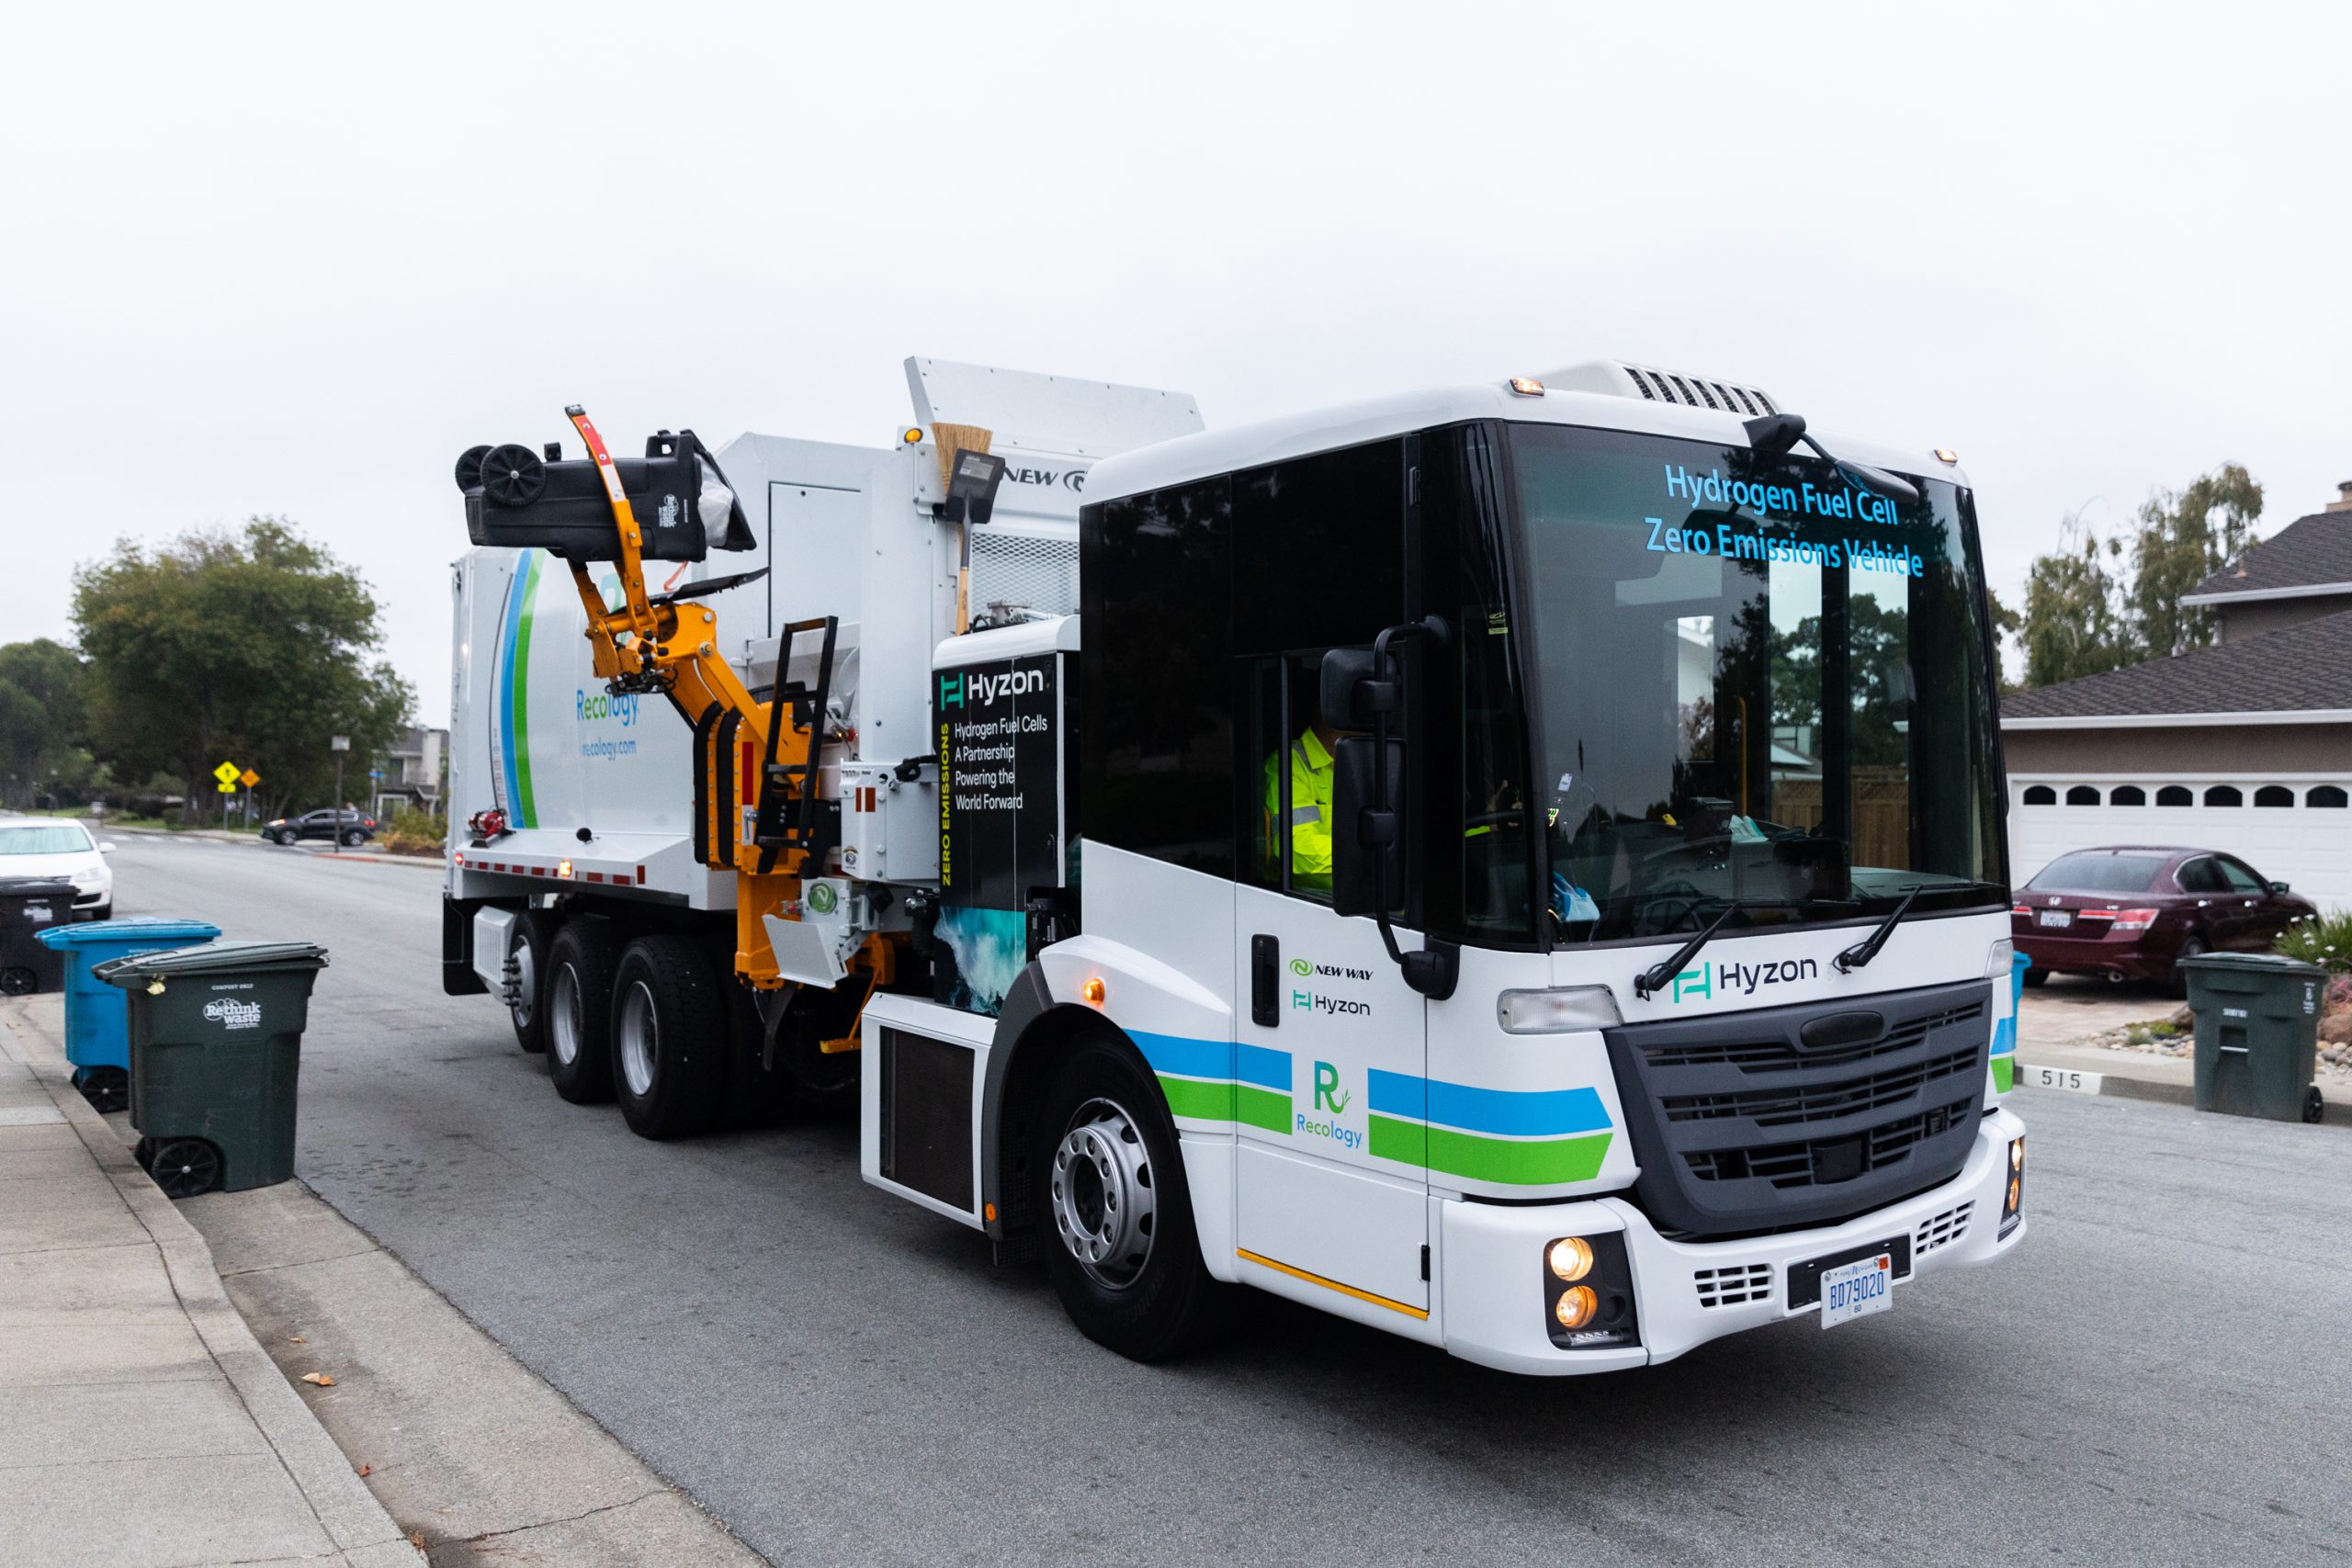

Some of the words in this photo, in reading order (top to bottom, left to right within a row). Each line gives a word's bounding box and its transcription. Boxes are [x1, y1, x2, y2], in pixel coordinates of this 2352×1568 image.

[1003, 467, 1058, 486] NEW
[1665, 464, 1798, 516] Hydrogen
[1801, 482, 1853, 519] Fuel
[1856, 491, 1898, 525] Cell
[1645, 516, 1711, 556] Zero
[1716, 524, 1842, 568] Emissions
[1842, 538, 1924, 578] Vehicle
[967, 669, 1044, 706] Hyzon
[576, 689, 639, 727] Recology
[955, 721, 999, 741] Hydrogen
[1000, 716, 1020, 734] Fuel
[1022, 714, 1047, 733] Cells
[582, 736, 637, 761] recology.com
[955, 746, 962, 762] A
[963, 742, 1015, 763] Partnership
[941, 722, 951, 829] EMISSIONS
[956, 768, 997, 789] Powering
[998, 767, 1015, 784] the
[956, 794, 982, 810] World
[983, 792, 1023, 809] Forward
[942, 834, 952, 886] ZERO
[1315, 964, 1344, 977] NEW
[1345, 967, 1374, 980] WAY
[1719, 958, 1818, 996] Hyzon
[206, 1001, 261, 1017] Rethink
[1315, 994, 1371, 1016] Hyzon
[223, 1013, 261, 1024] waste
[2041, 1069, 2081, 1089] 515
[1296, 1113, 1363, 1149] Recology
[1829, 1270, 1884, 1310] BD79020
